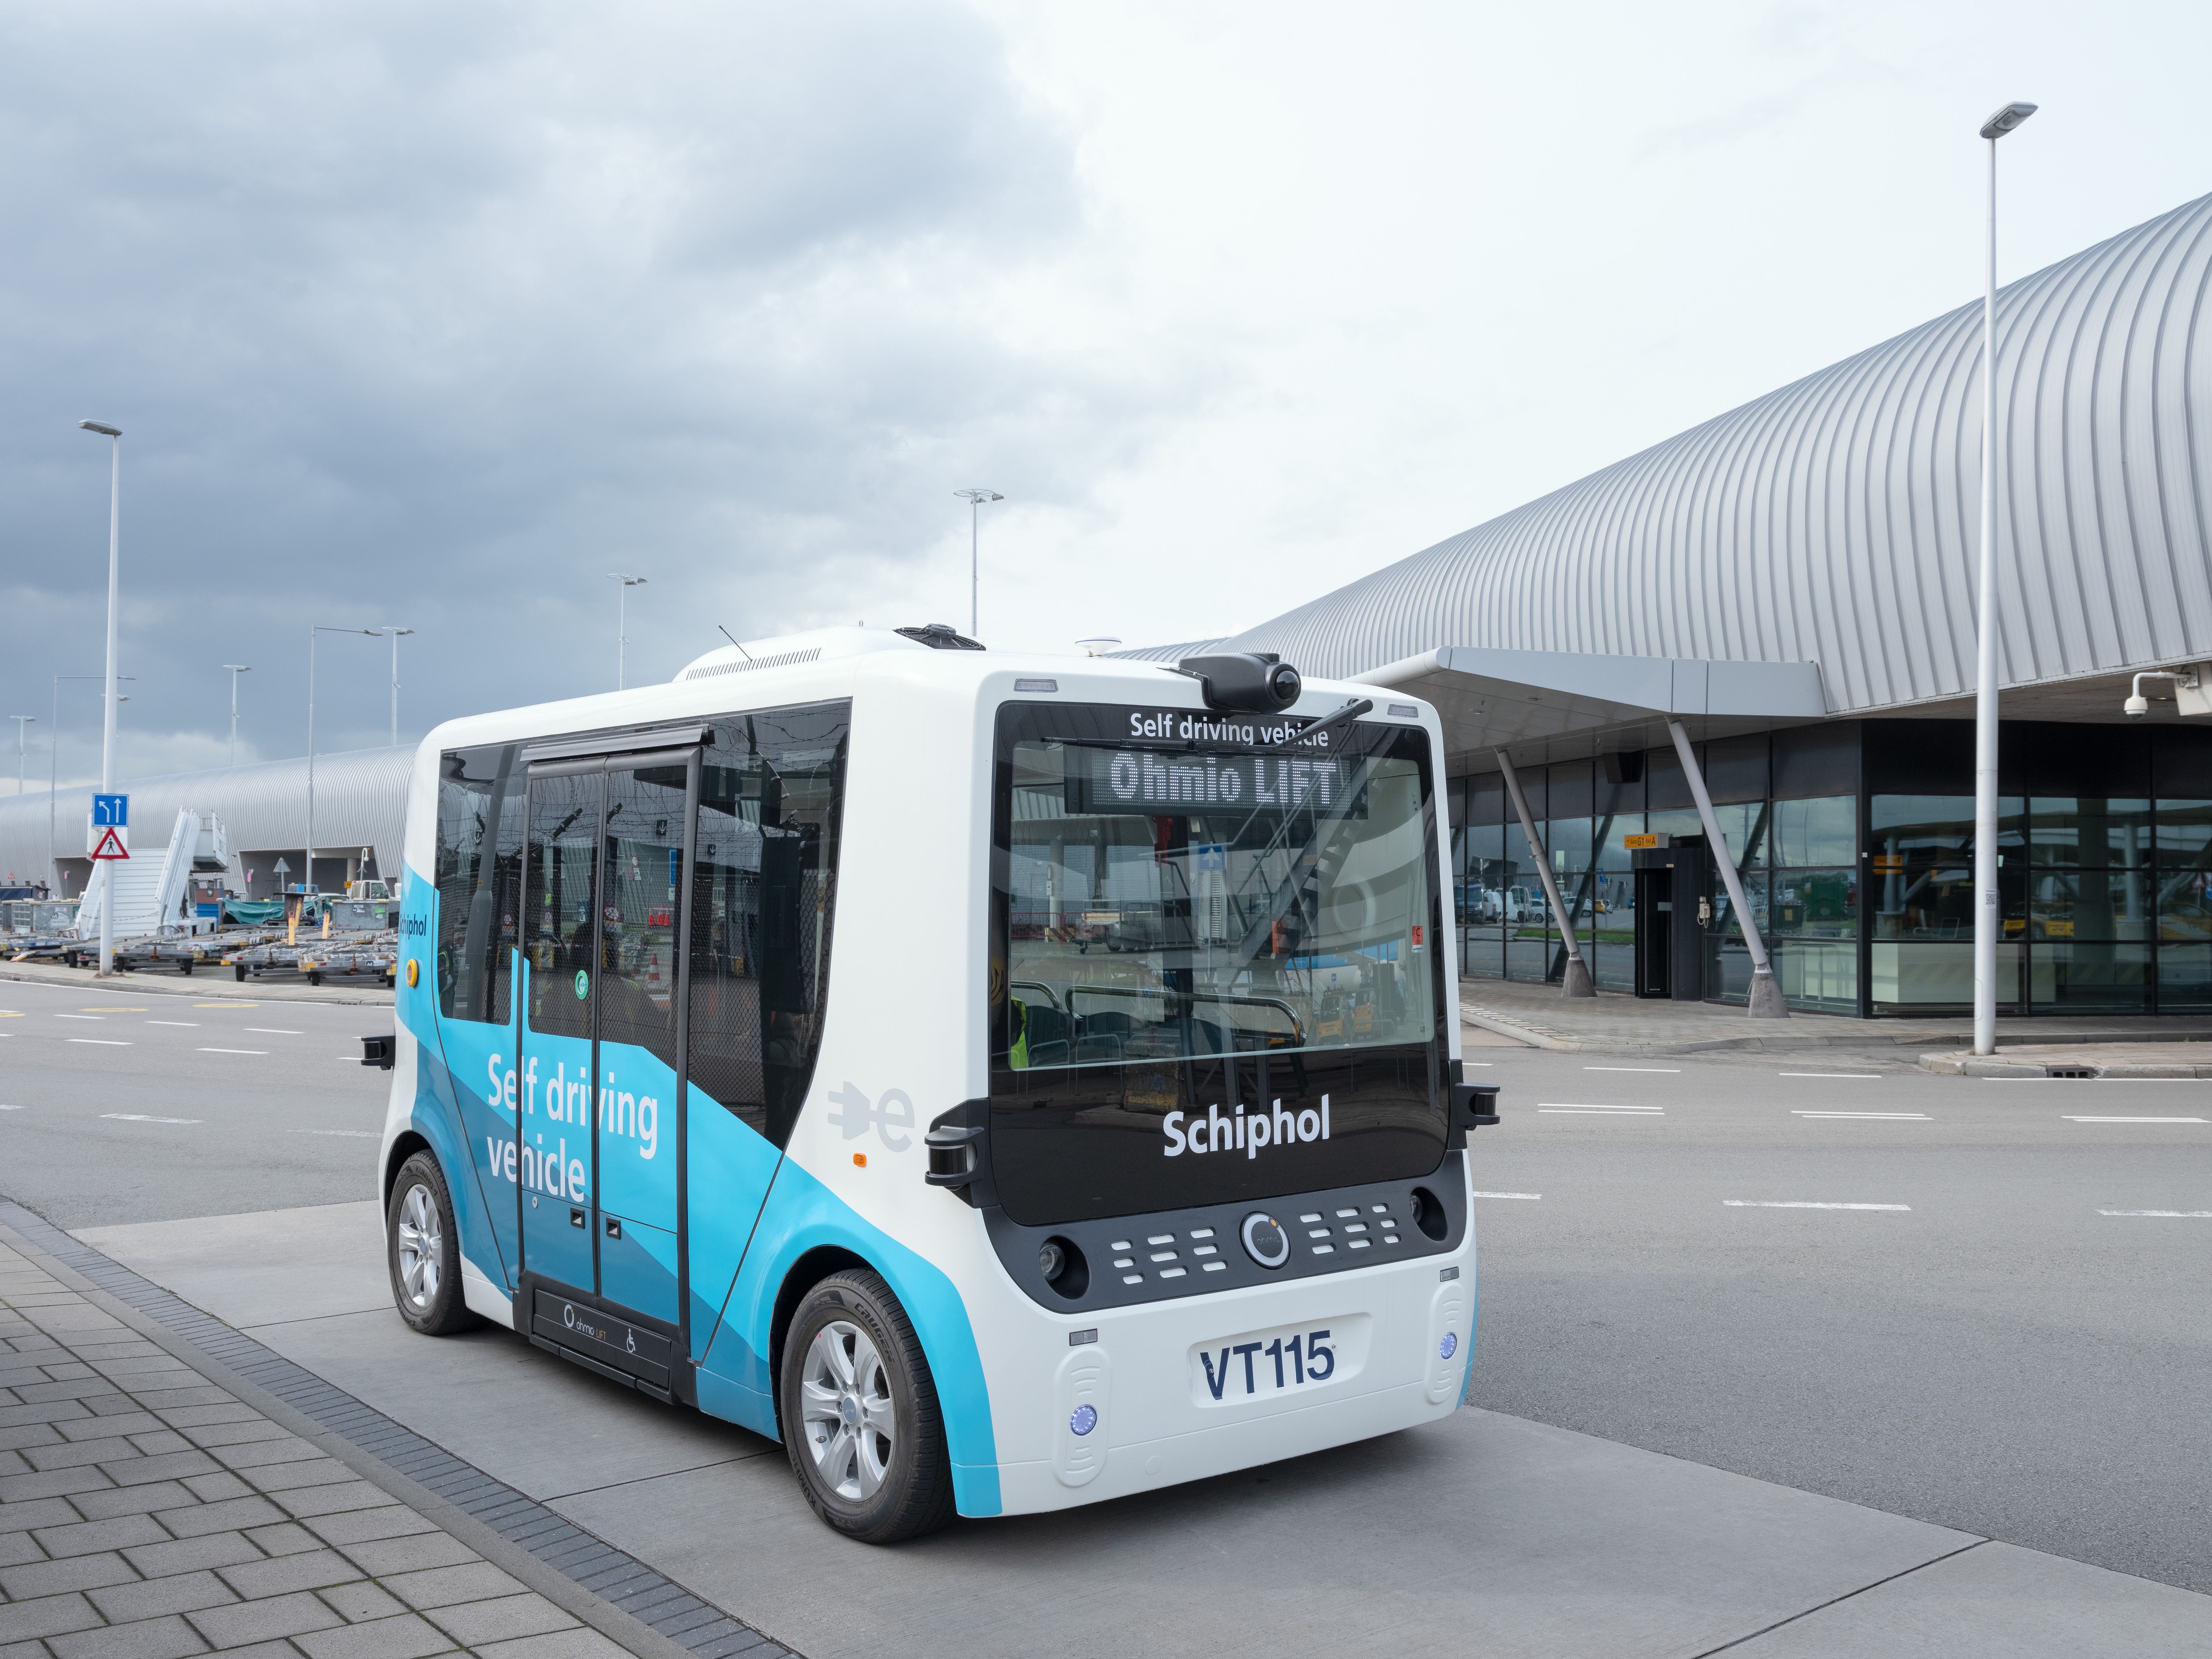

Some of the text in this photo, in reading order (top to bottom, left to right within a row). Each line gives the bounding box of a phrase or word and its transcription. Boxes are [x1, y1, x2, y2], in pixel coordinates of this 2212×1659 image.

[1130, 713, 1172, 737] Self
[1179, 715, 1254, 746] driving
[1110, 750, 1336, 805] Ohmio LIFT
[1638, 837, 1644, 846] G1
[1652, 836, 1656, 845] A
[399, 912, 427, 940] Schiphol
[546, 1062, 657, 1160] driving
[1164, 1094, 1330, 1159] Schiphol
[415, 1166, 434, 1190] KUMHO
[487, 1128, 585, 1202] vehicle
[1257, 1235, 1280, 1244] ohmio
[576, 1318, 606, 1340] ohmio LIFT
[854, 1302, 895, 1363] CRUGEN
[1200, 1330, 1335, 1401] VT115
